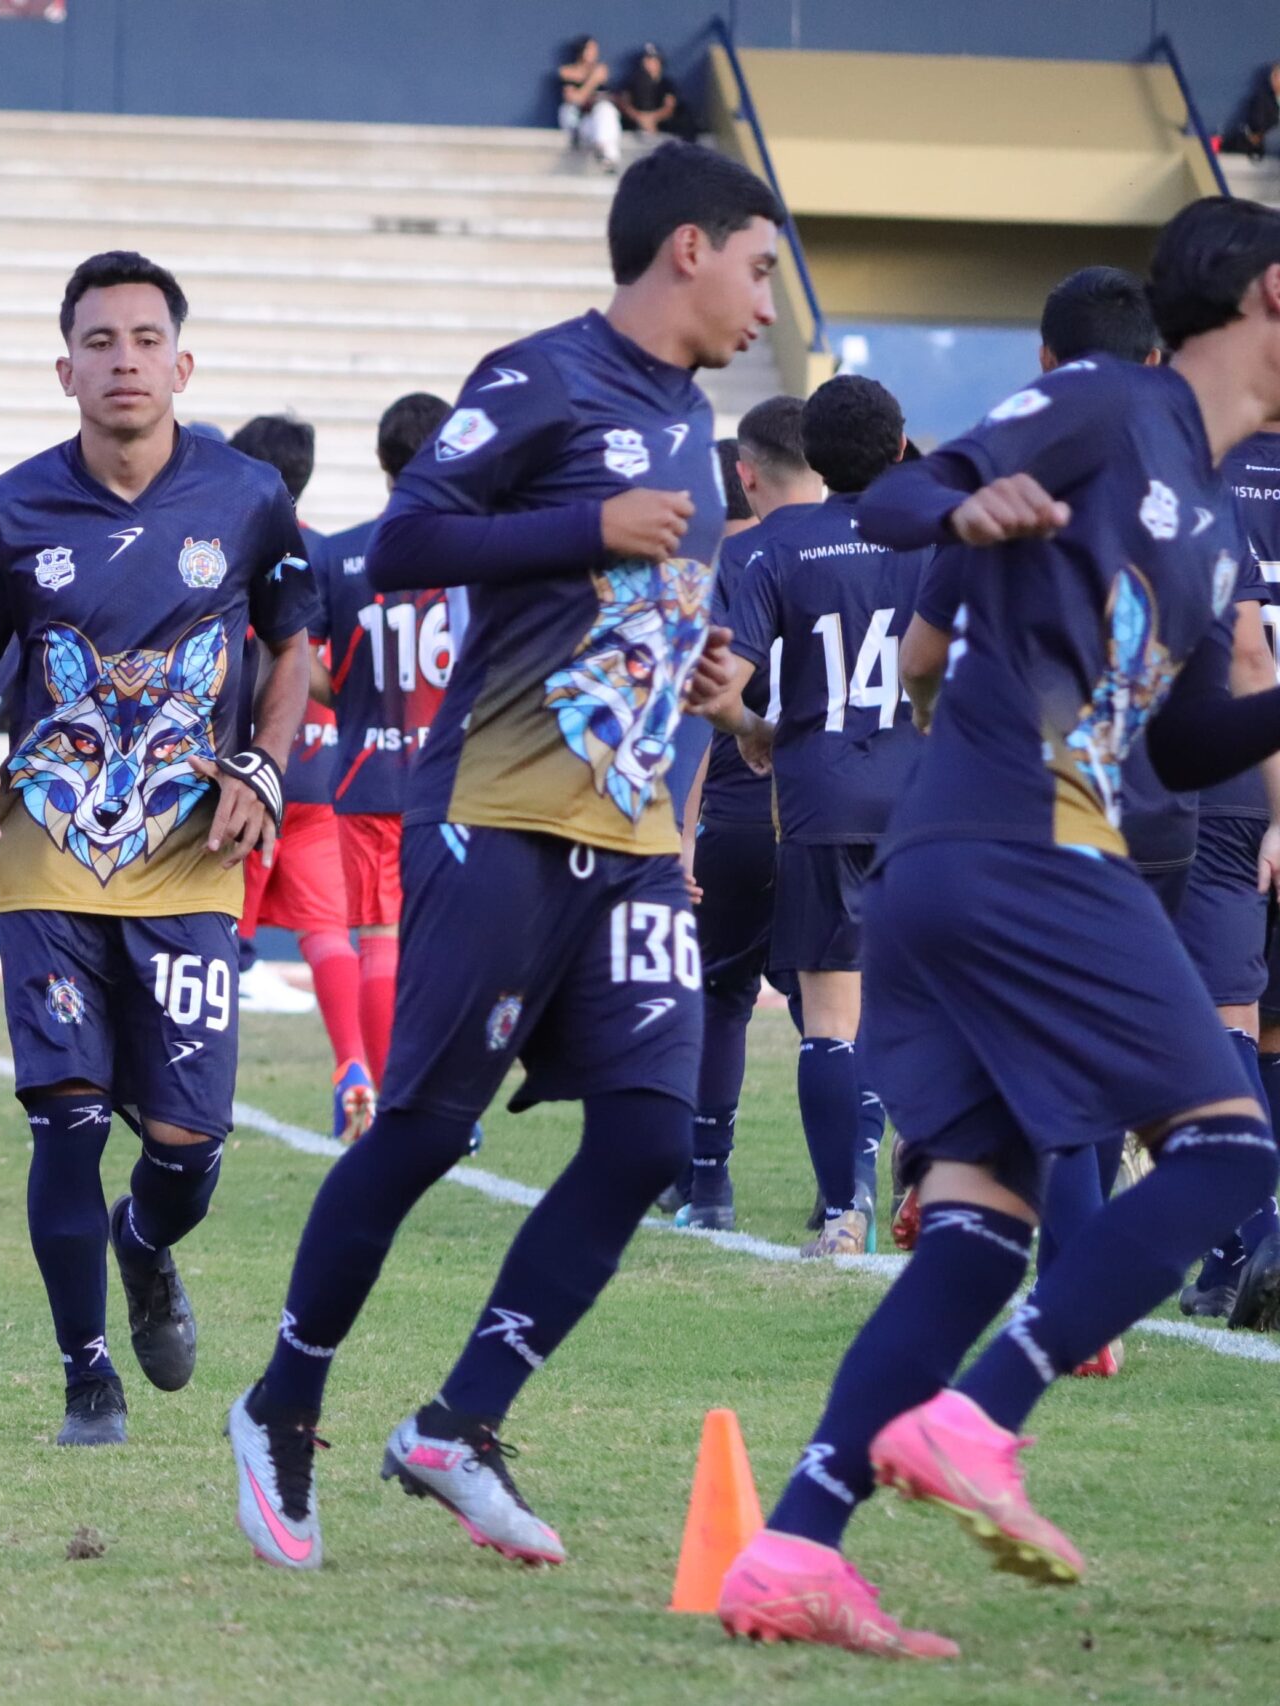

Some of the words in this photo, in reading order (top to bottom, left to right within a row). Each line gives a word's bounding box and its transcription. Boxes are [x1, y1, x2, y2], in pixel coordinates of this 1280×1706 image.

[1231, 485, 1263, 500] ISTA
[800, 542, 870, 562] HUMANISTA
[358, 602, 455, 693] 116
[811, 607, 911, 733] 14
[611, 901, 702, 992] 136
[149, 952, 231, 1032] 169
